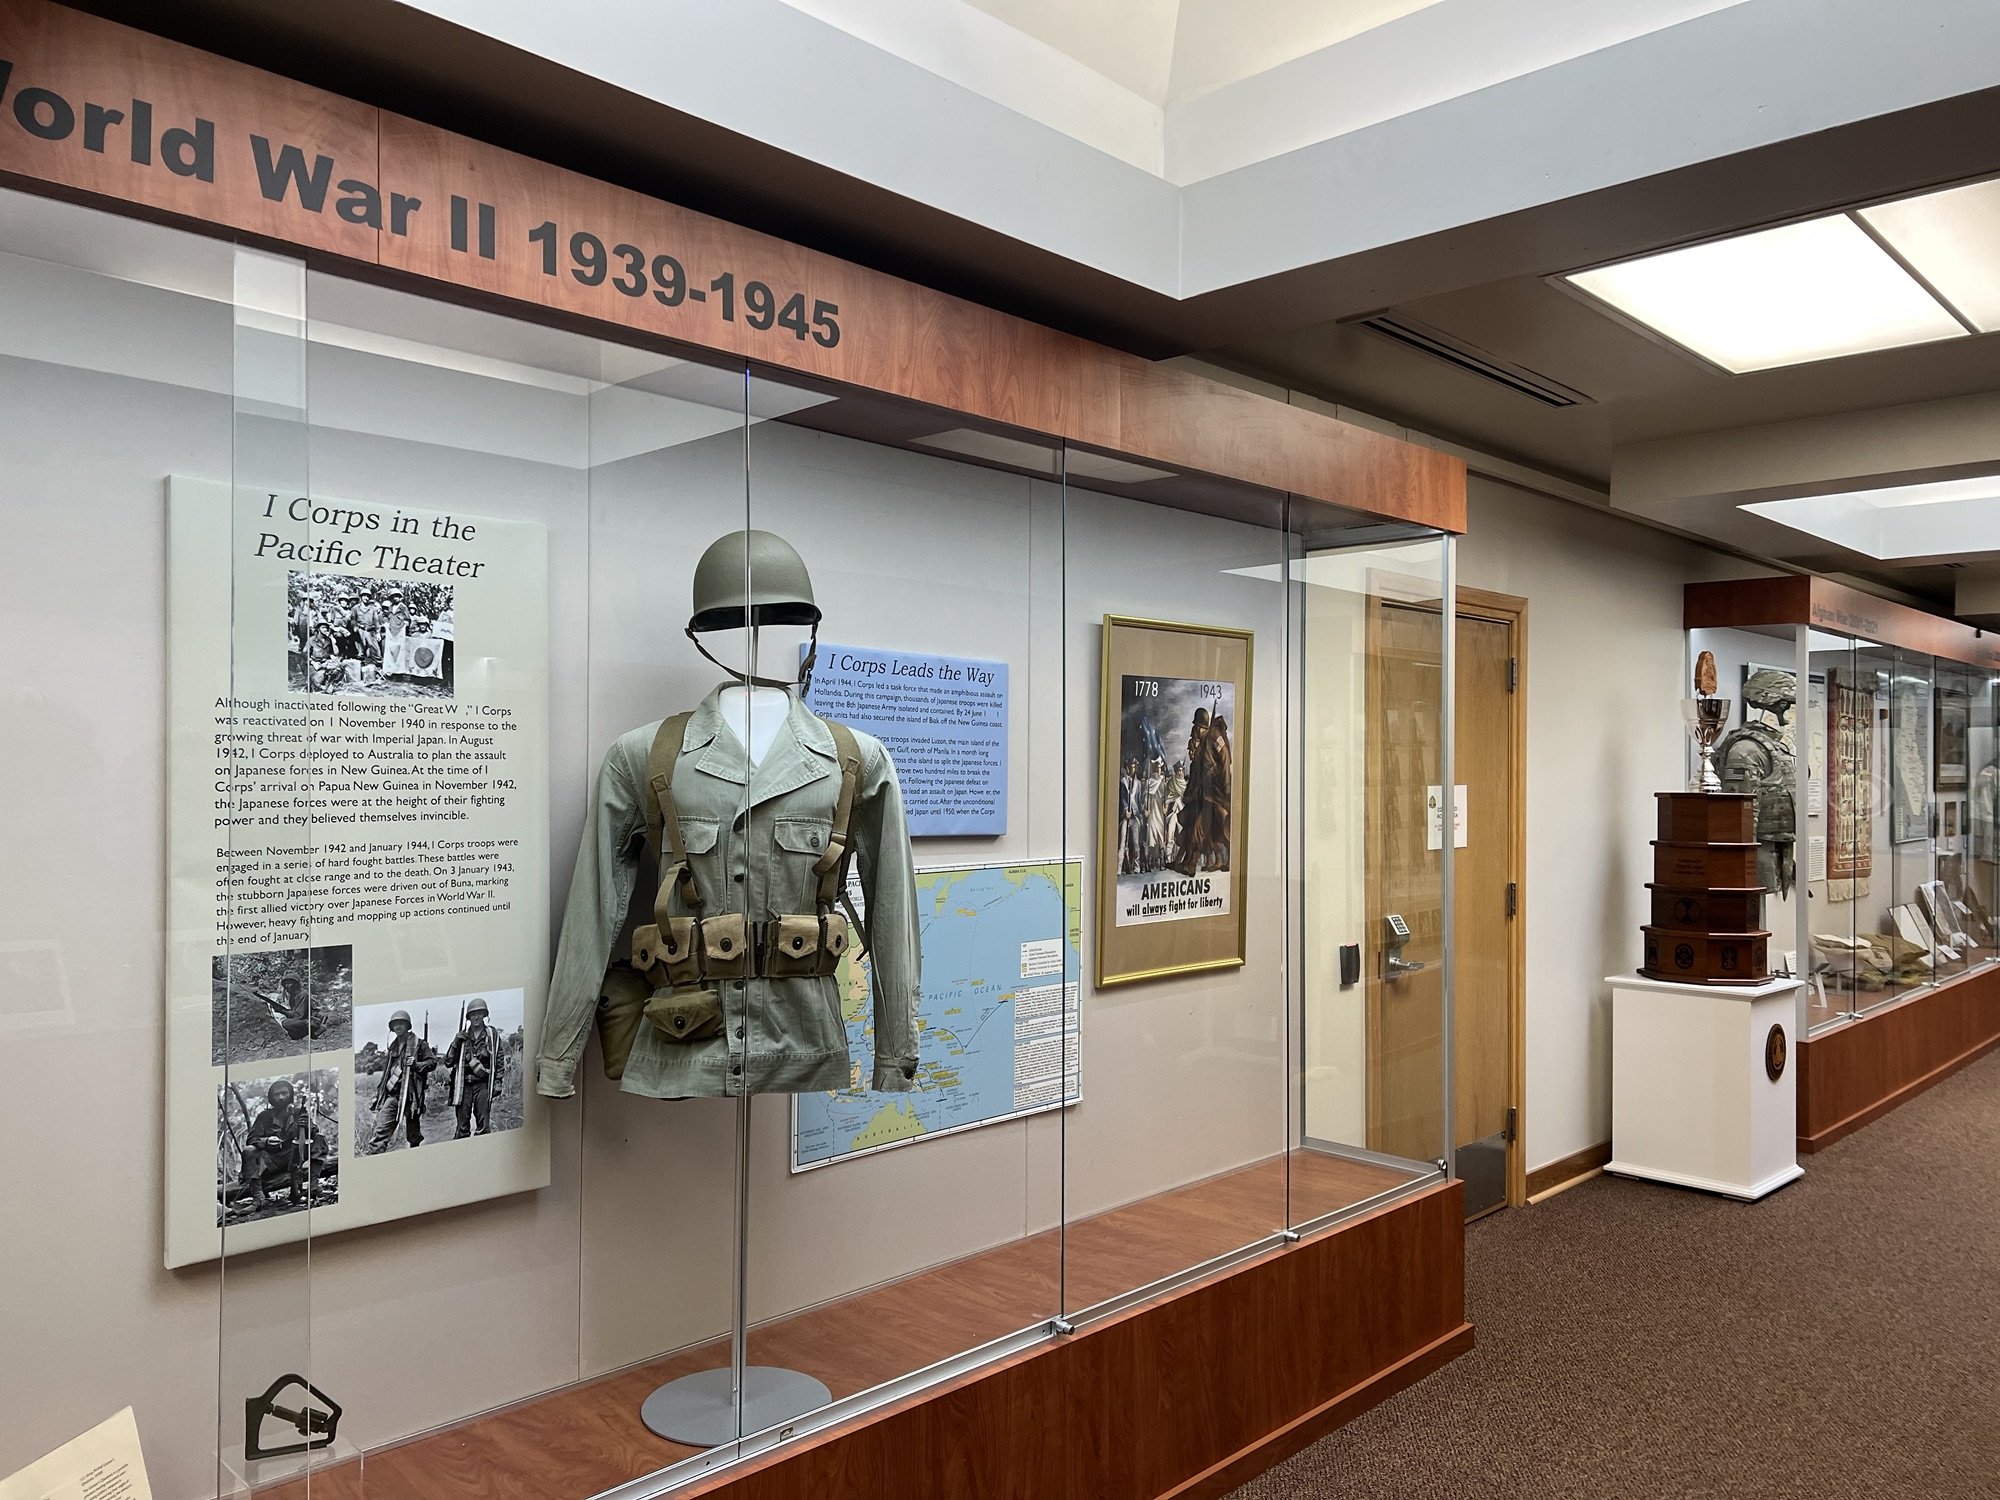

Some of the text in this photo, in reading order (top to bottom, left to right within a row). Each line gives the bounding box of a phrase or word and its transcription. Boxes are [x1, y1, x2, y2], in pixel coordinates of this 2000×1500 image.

[0, 61, 841, 349] orld War II 1939-1945
[263, 493, 476, 541] I Corps in the
[254, 532, 485, 578] Pacific Theater
[829, 653, 995, 687] I Corps Leads the Way
[1134, 680, 1159, 697] 1778
[1200, 684, 1222, 700] 1943
[337, 701, 386, 715] following
[390, 703, 406, 713] the
[482, 706, 512, 718] Corps
[214, 717, 238, 725] was
[242, 716, 306, 726] reactivated
[339, 717, 396, 728] November
[401, 719, 425, 728] 1940
[428, 720, 437, 729] in
[440, 722, 485, 732] response
[501, 721, 517, 730] the
[214, 732, 264, 745] growing
[267, 732, 302, 742] threat
[306, 732, 318, 742] of
[344, 733, 368, 743] with
[372, 734, 414, 746] Imperial
[416, 734, 446, 747] Japan.
[448, 735, 458, 744] In
[459, 735, 494, 747] August
[216, 748, 248, 760] 1942,
[259, 748, 296, 761] Corps
[300, 749, 348, 762] deployed
[368, 749, 414, 759] Australia
[432, 750, 452, 762] plan
[455, 750, 472, 759] the
[474, 750, 506, 760] assault
[234, 765, 286, 778] Japanese
[327, 765, 337, 775] in
[341, 765, 367, 775] New
[370, 765, 410, 775] Guinea.
[411, 765, 424, 775] At
[427, 765, 444, 775] the
[447, 766, 470, 774] time
[472, 765, 483, 774] of
[260, 781, 296, 791] arrival
[318, 781, 350, 794] Papua
[353, 781, 379, 790] New
[382, 780, 419, 790] Guinea
[422, 781, 431, 790] in
[435, 780, 488, 790] November
[492, 780, 517, 790] 1942,
[214, 798, 234, 809] the
[238, 798, 289, 811] Japanese
[292, 797, 327, 807] forces
[375, 796, 392, 806] the
[396, 796, 428, 808] height
[430, 795, 442, 805] of
[444, 795, 468, 805] their
[470, 795, 505, 807] fighting
[214, 810, 469, 829] power and they believed themselves invincible.
[216, 848, 263, 857] Between
[266, 845, 320, 855] November
[324, 844, 346, 853] 1942
[349, 843, 366, 852] and
[368, 843, 403, 854] January
[407, 841, 430, 850] 1944,
[437, 840, 464, 850] Corps
[467, 841, 495, 849] troops
[216, 862, 259, 874] engaged
[262, 862, 272, 870] in
[315, 858, 326, 868] of
[328, 858, 350, 867] hard
[352, 857, 382, 868] fought
[384, 855, 417, 864] battles.
[418, 854, 444, 863] These
[447, 853, 475, 861] battles
[1141, 878, 1211, 900] AMERICANS
[1126, 896, 1223, 916] will always fight for liberty
[238, 934, 256, 944] end
[260, 932, 271, 942] of
[273, 932, 310, 944] January
[928, 984, 1002, 1001] PACIFIC OCEAN
[856, 1122, 921, 1141] AUSTRALIA
